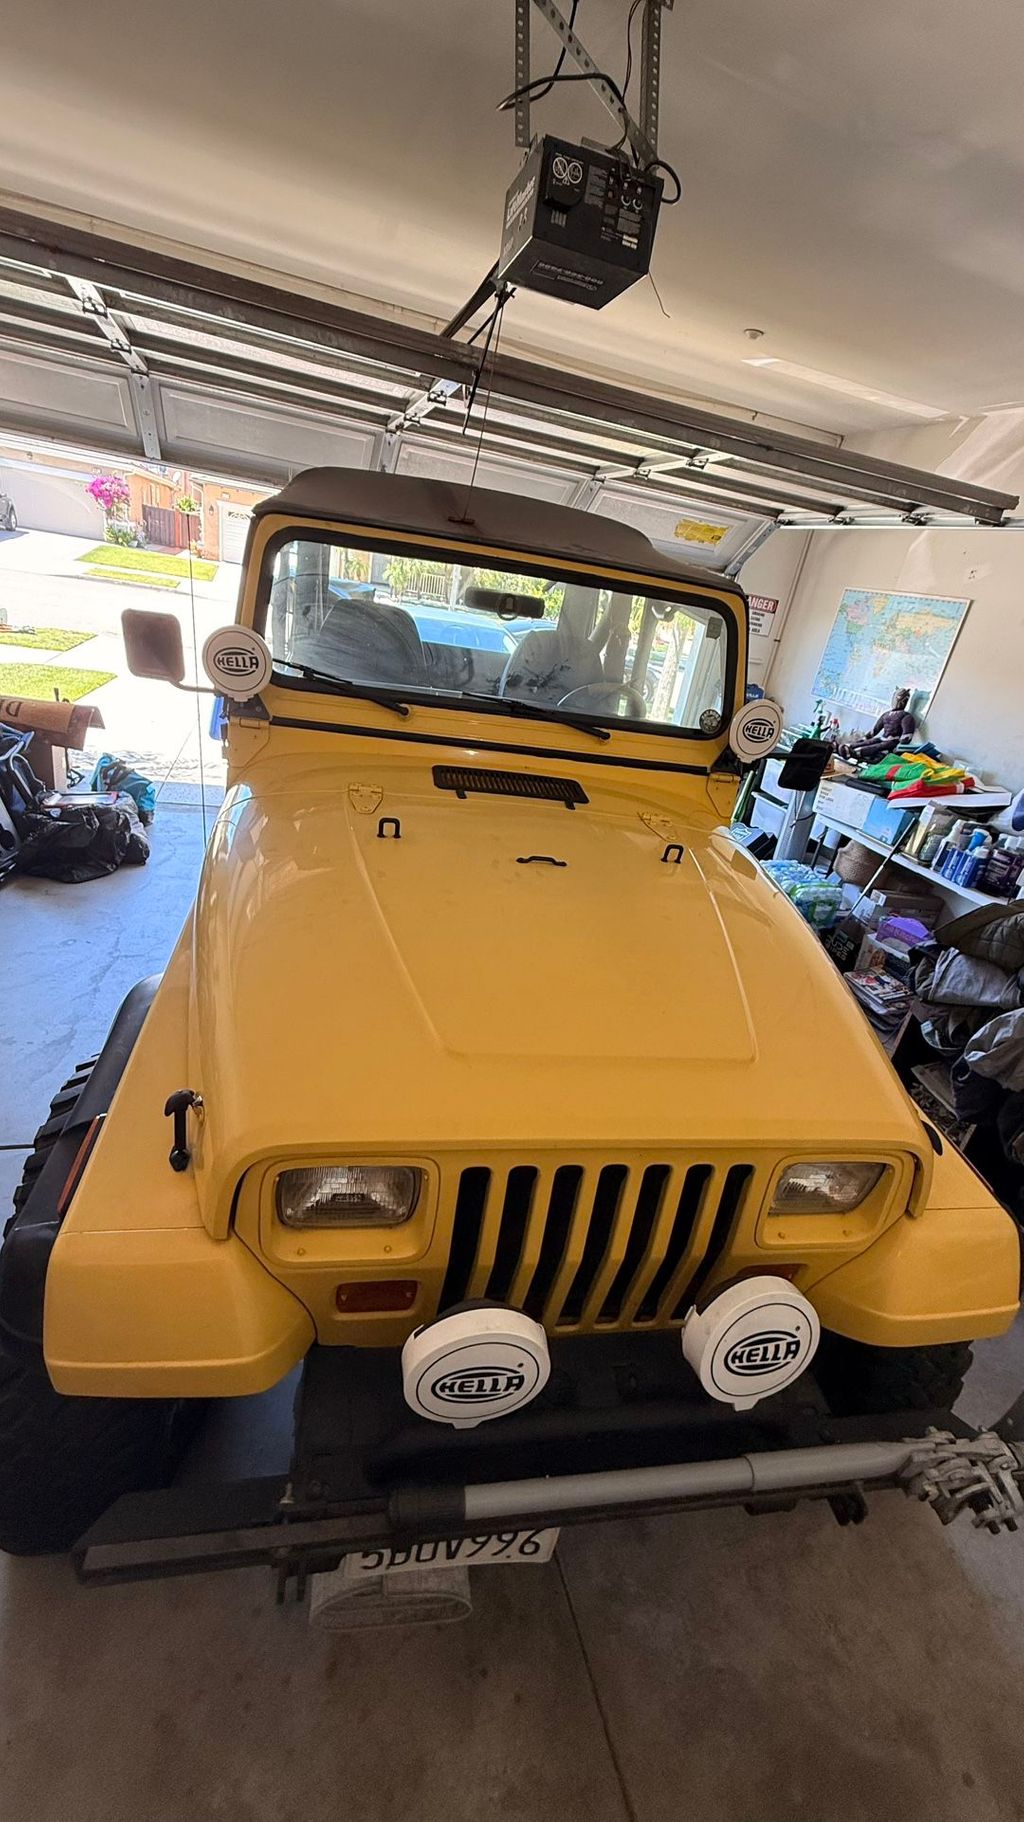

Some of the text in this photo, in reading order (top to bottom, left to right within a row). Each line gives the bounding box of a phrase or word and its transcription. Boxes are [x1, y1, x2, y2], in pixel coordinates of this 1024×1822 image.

[747, 596, 775, 611] ANGER
[217, 656, 260, 669] HELLA
[745, 725, 775, 739] HELLA
[730, 1339, 801, 1365] HELLA
[439, 1374, 525, 1393] HELLA
